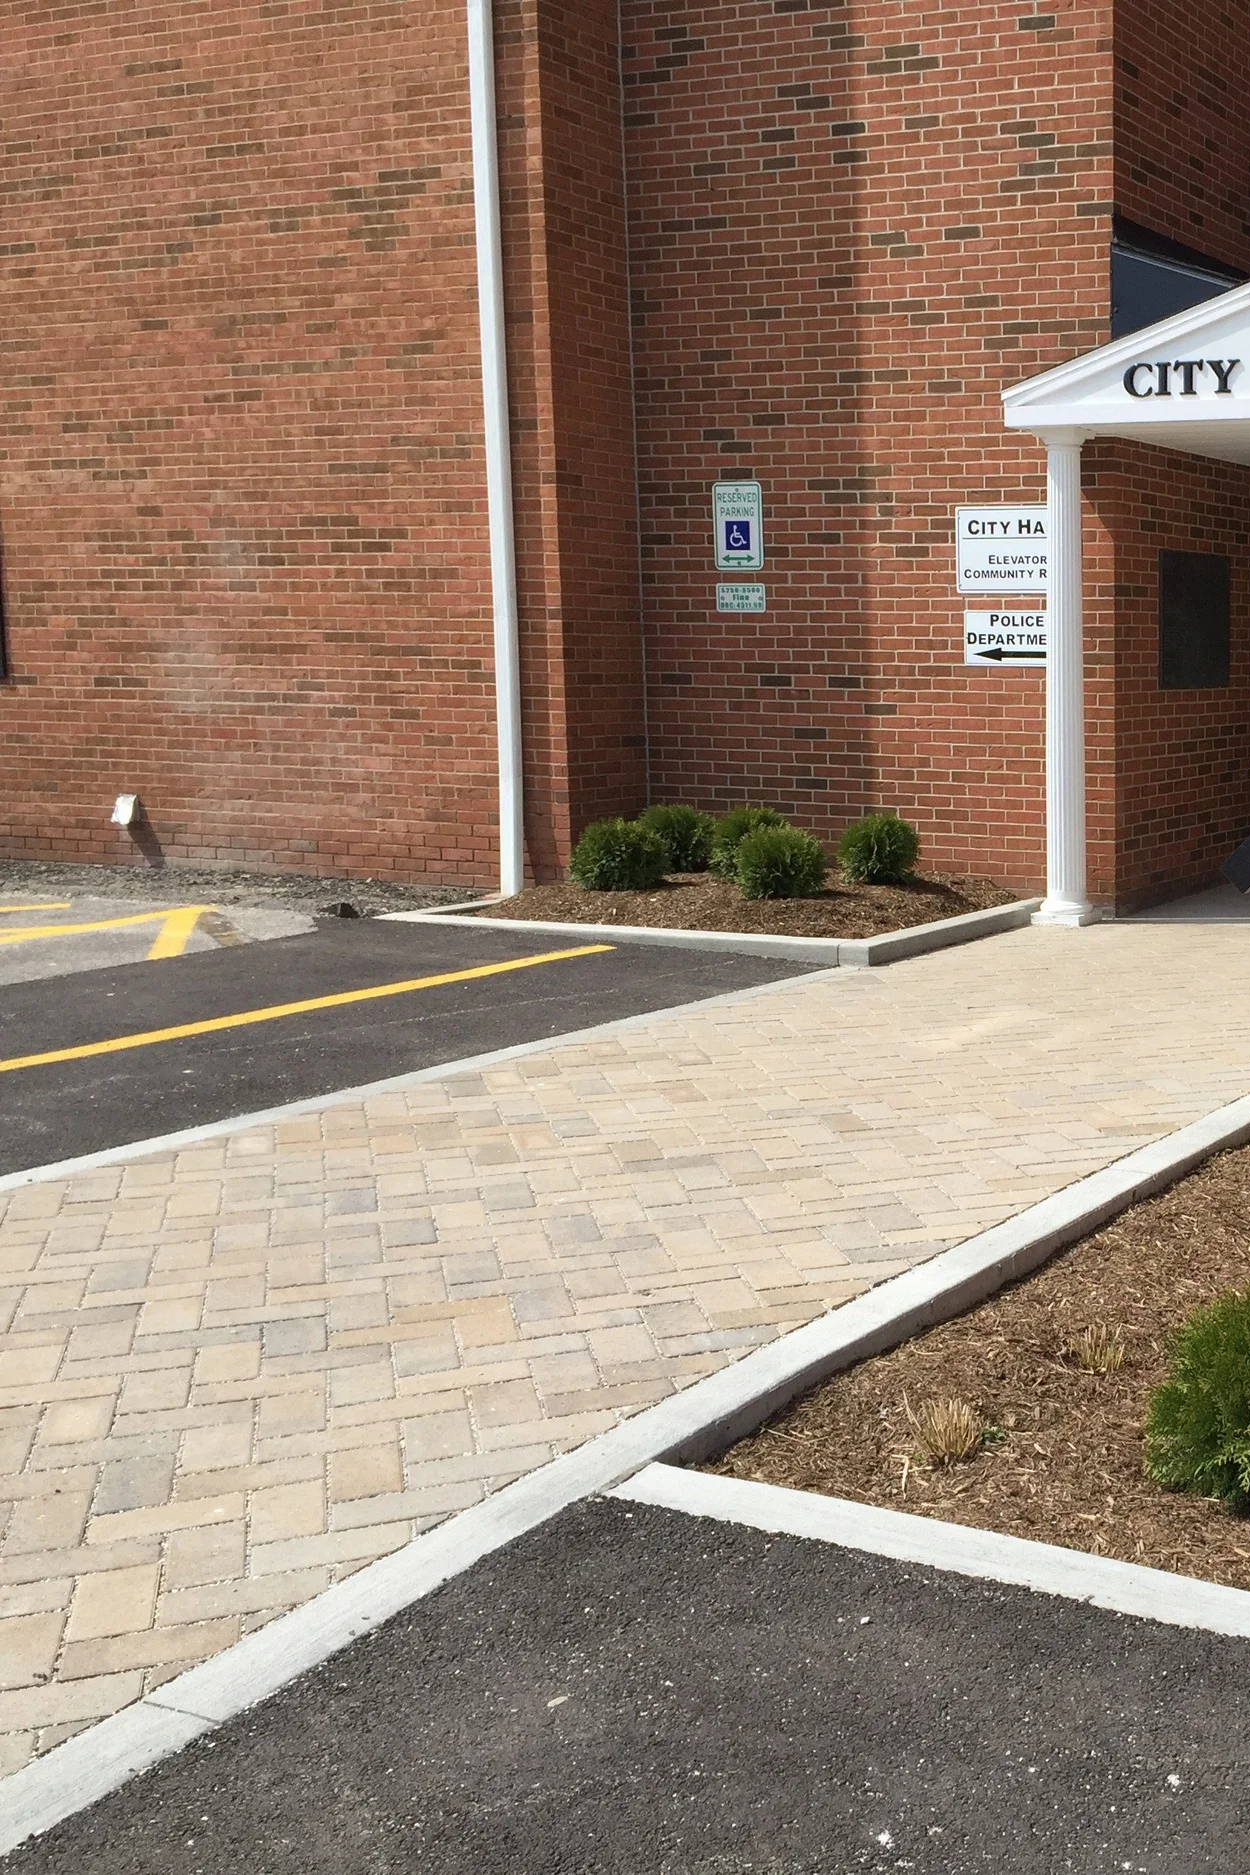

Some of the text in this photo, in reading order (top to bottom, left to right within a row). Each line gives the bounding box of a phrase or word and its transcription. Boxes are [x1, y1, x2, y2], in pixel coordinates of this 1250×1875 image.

[1123, 358, 1240, 398] CITY
[717, 492, 757, 503] RESERVED
[720, 506, 755, 517] PARKING
[968, 519, 1045, 535] CITY HA
[988, 554, 1047, 565] ELEVATOR
[964, 568, 1035, 579] COMMUNITY
[990, 614, 1045, 627] POLICE
[967, 632, 1047, 646] DEPARTME
